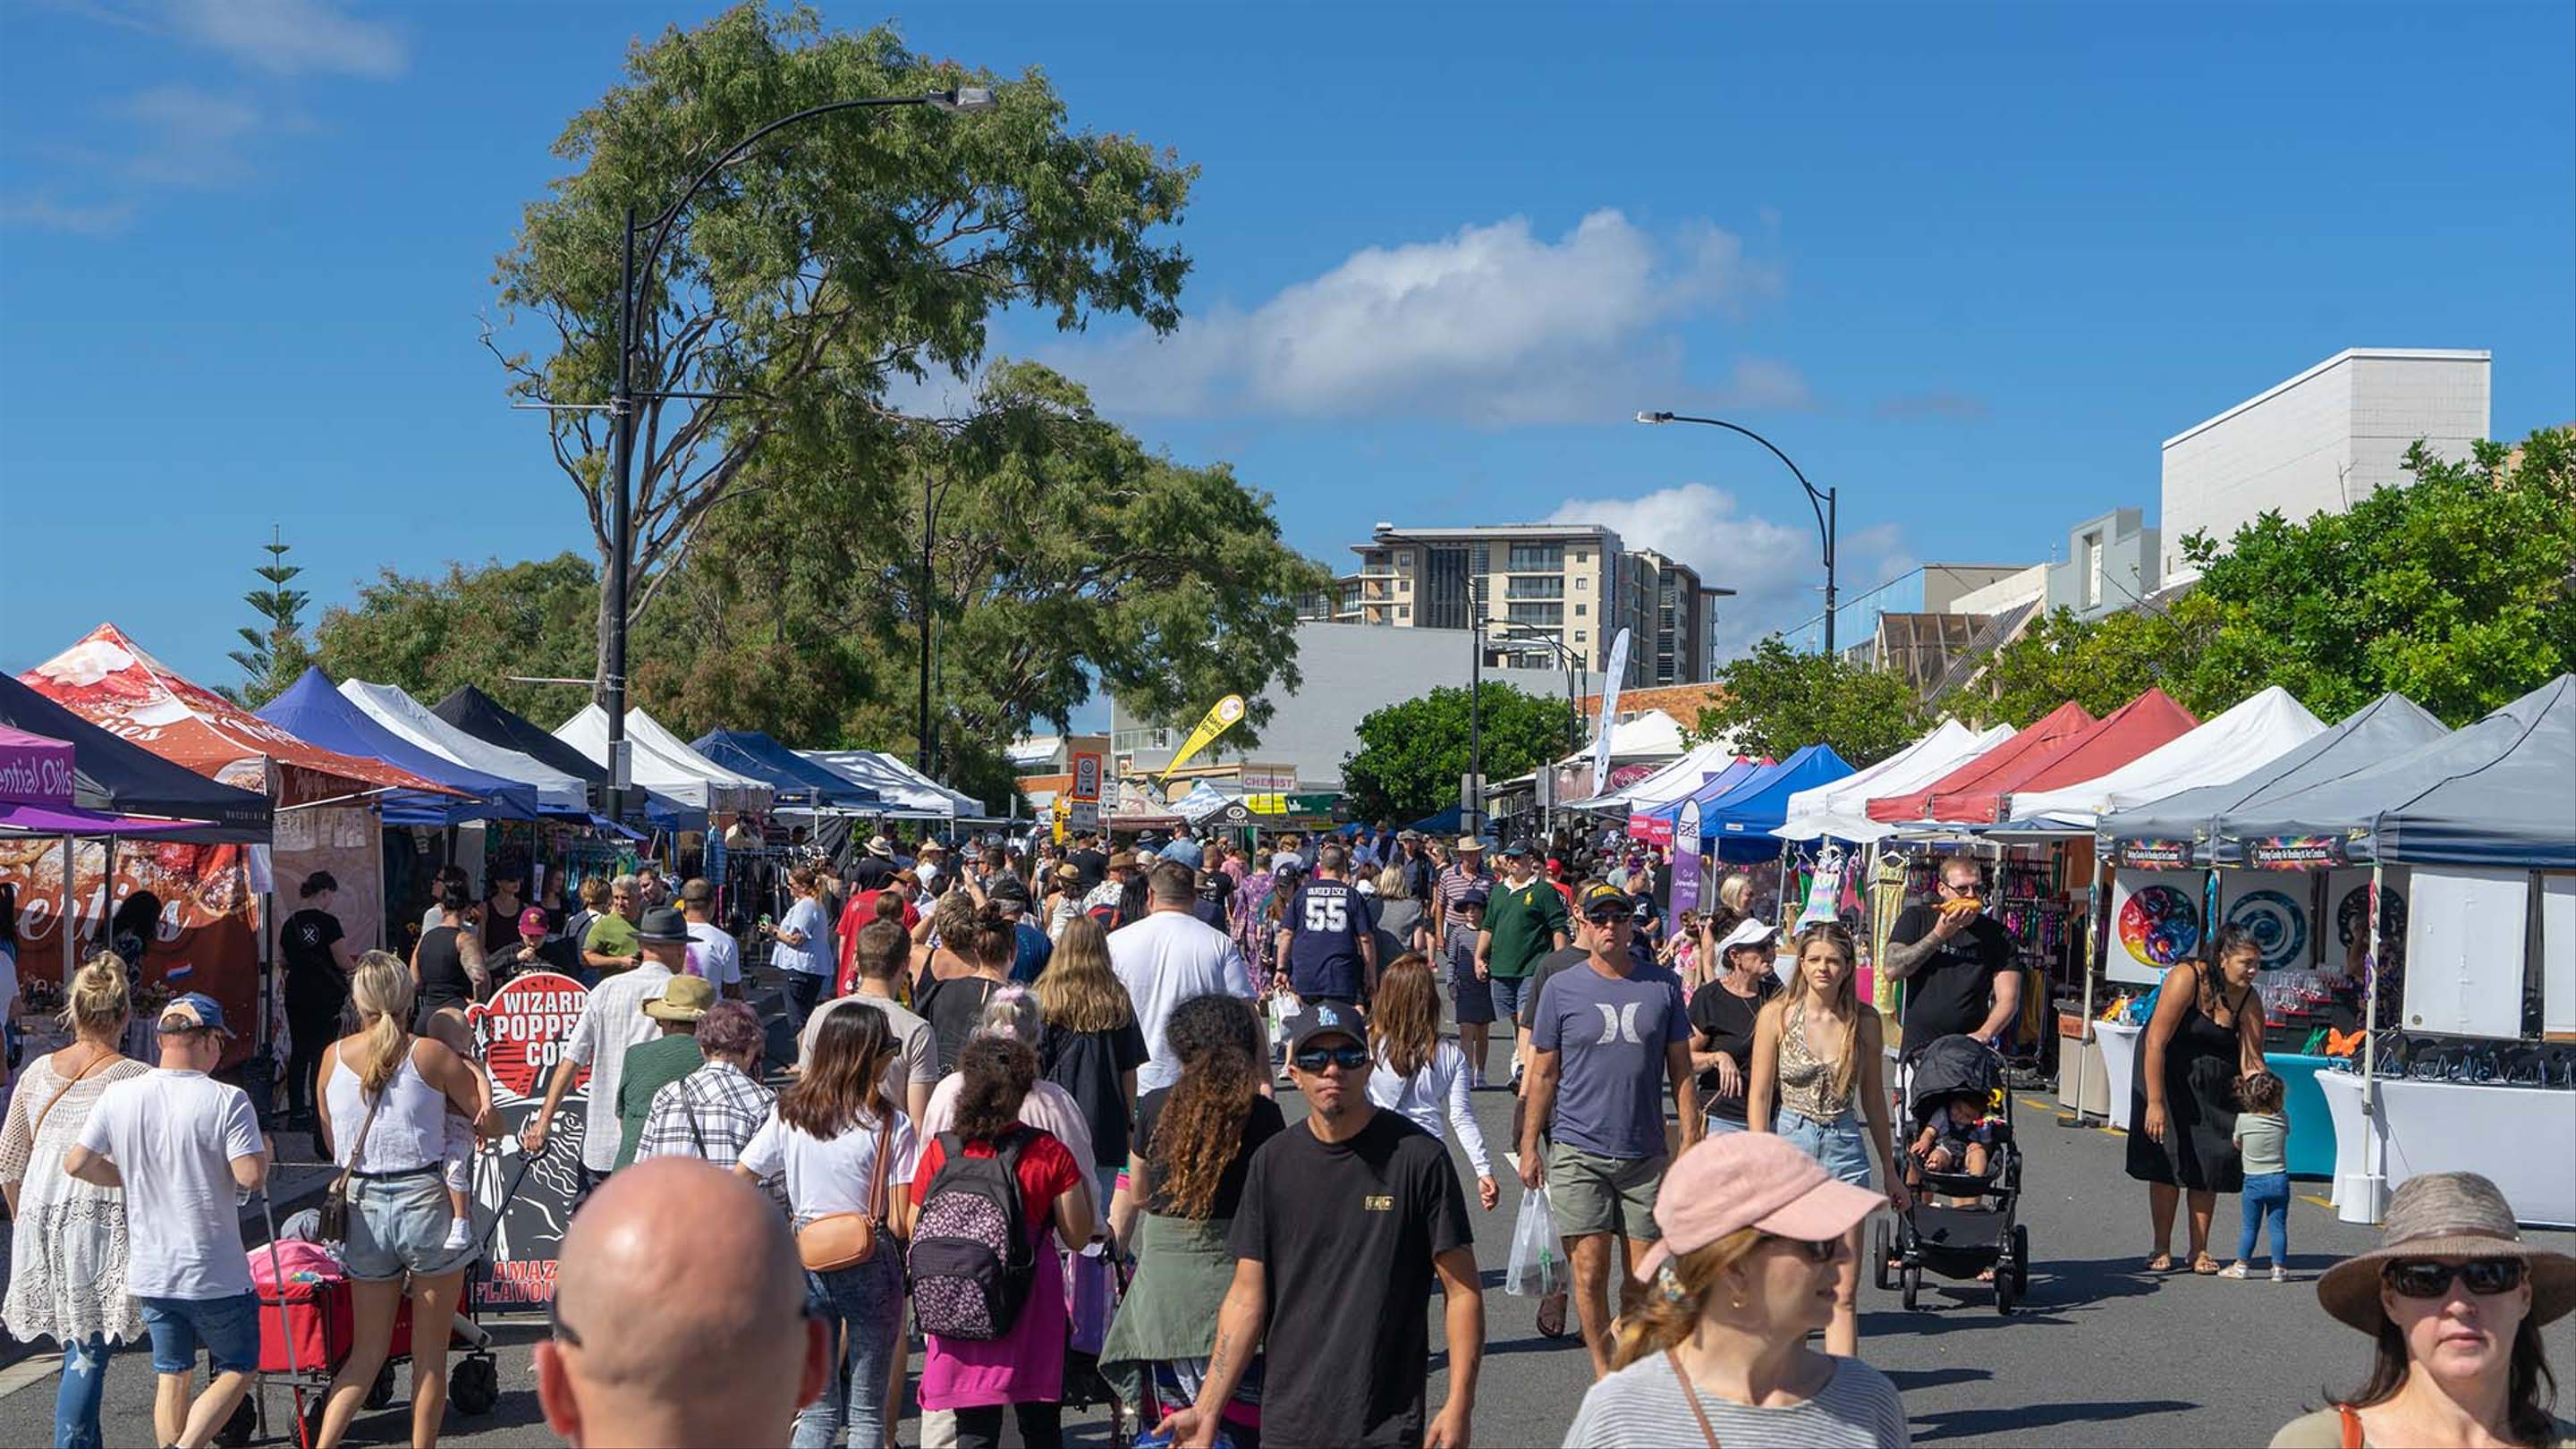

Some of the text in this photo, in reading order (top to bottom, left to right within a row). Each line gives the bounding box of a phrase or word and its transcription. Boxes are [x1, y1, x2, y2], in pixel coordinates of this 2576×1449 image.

[43, 758, 72, 795] Oils
[1244, 777, 1293, 788] CHEMIST
[1305, 897, 1348, 932] 55
[502, 991, 587, 1013] WIZARD
[1318, 1006, 1338, 1026] LA
[493, 1014, 581, 1042] POPPE
[494, 1259, 558, 1281] AMAZ
[476, 1280, 556, 1302] FLAVOU
